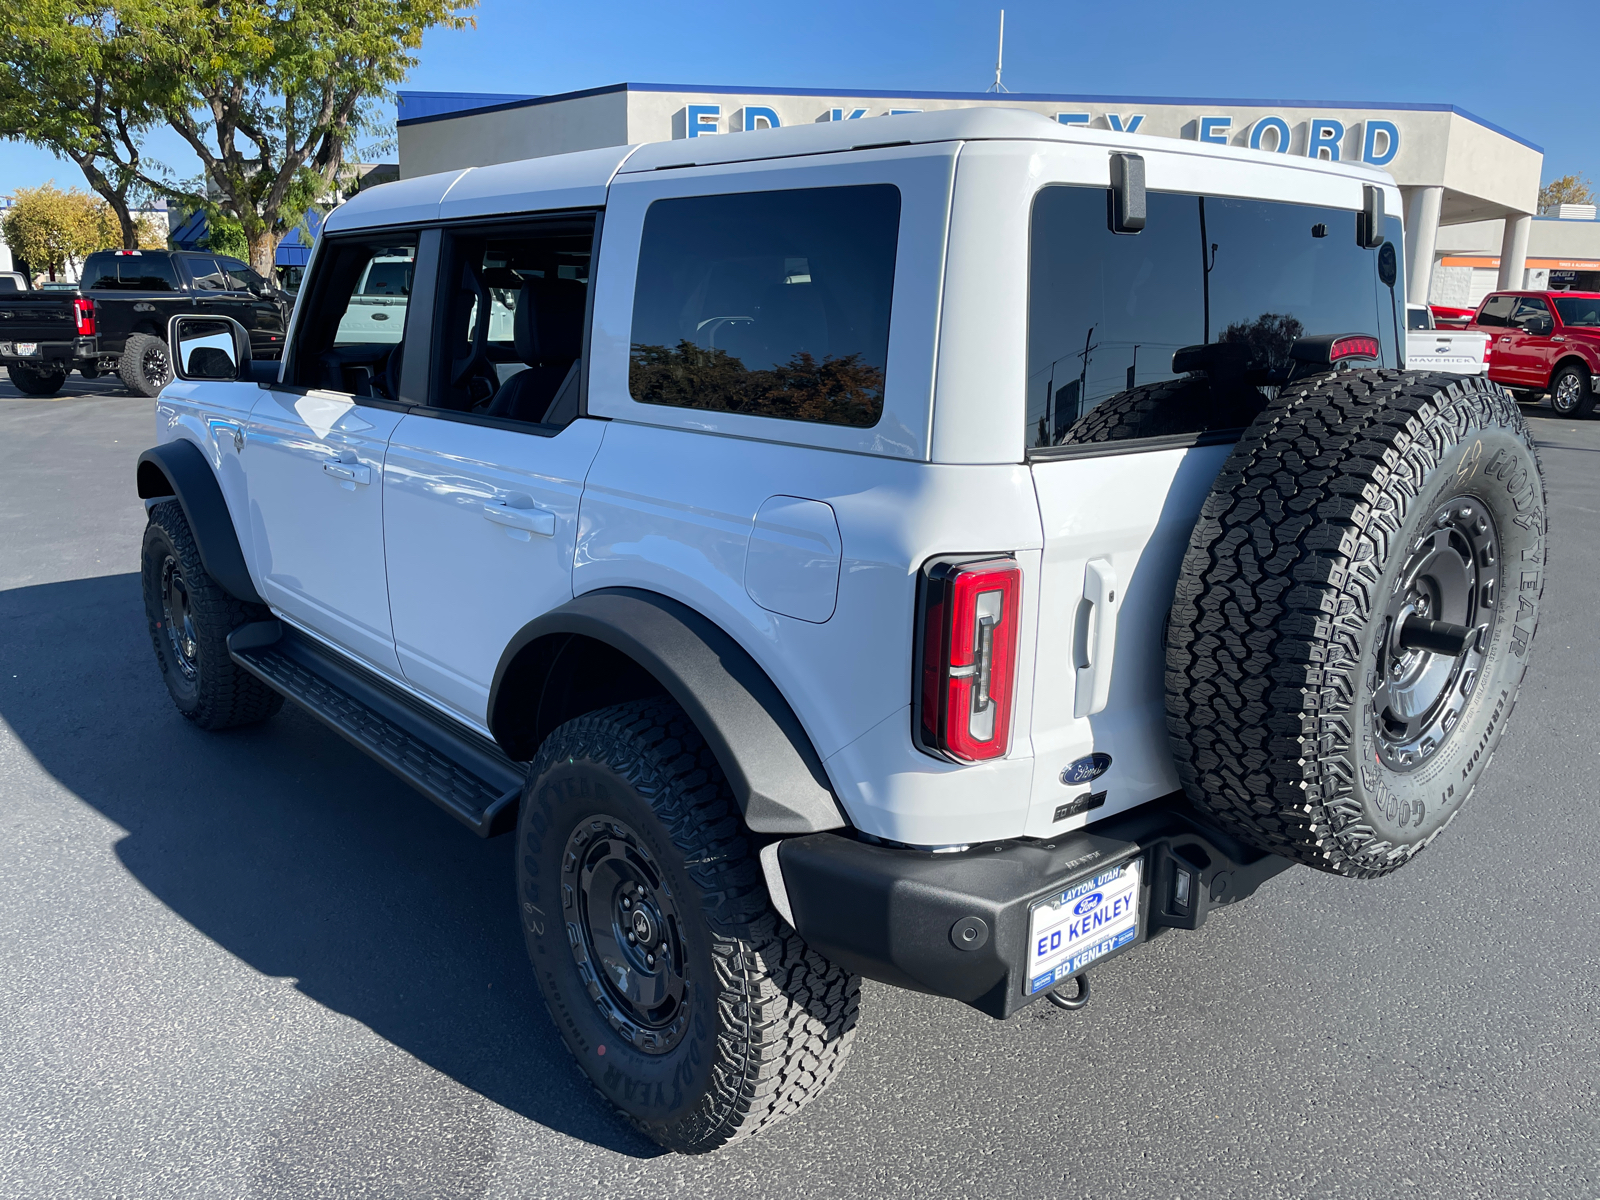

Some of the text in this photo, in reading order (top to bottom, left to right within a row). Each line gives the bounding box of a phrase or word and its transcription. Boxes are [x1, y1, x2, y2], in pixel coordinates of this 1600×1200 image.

[685, 104, 782, 138] ED
[1198, 115, 1401, 168] FORD
[1462, 689, 1509, 782] TERRITORY
[1441, 784, 1454, 804] RT
[1060, 867, 1120, 904] LAYTON, UTAH
[1037, 930, 1062, 957] ED
[1069, 891, 1133, 942] KENLEY
[1054, 961, 1071, 980] ED
[1073, 937, 1116, 970] KENLEY
